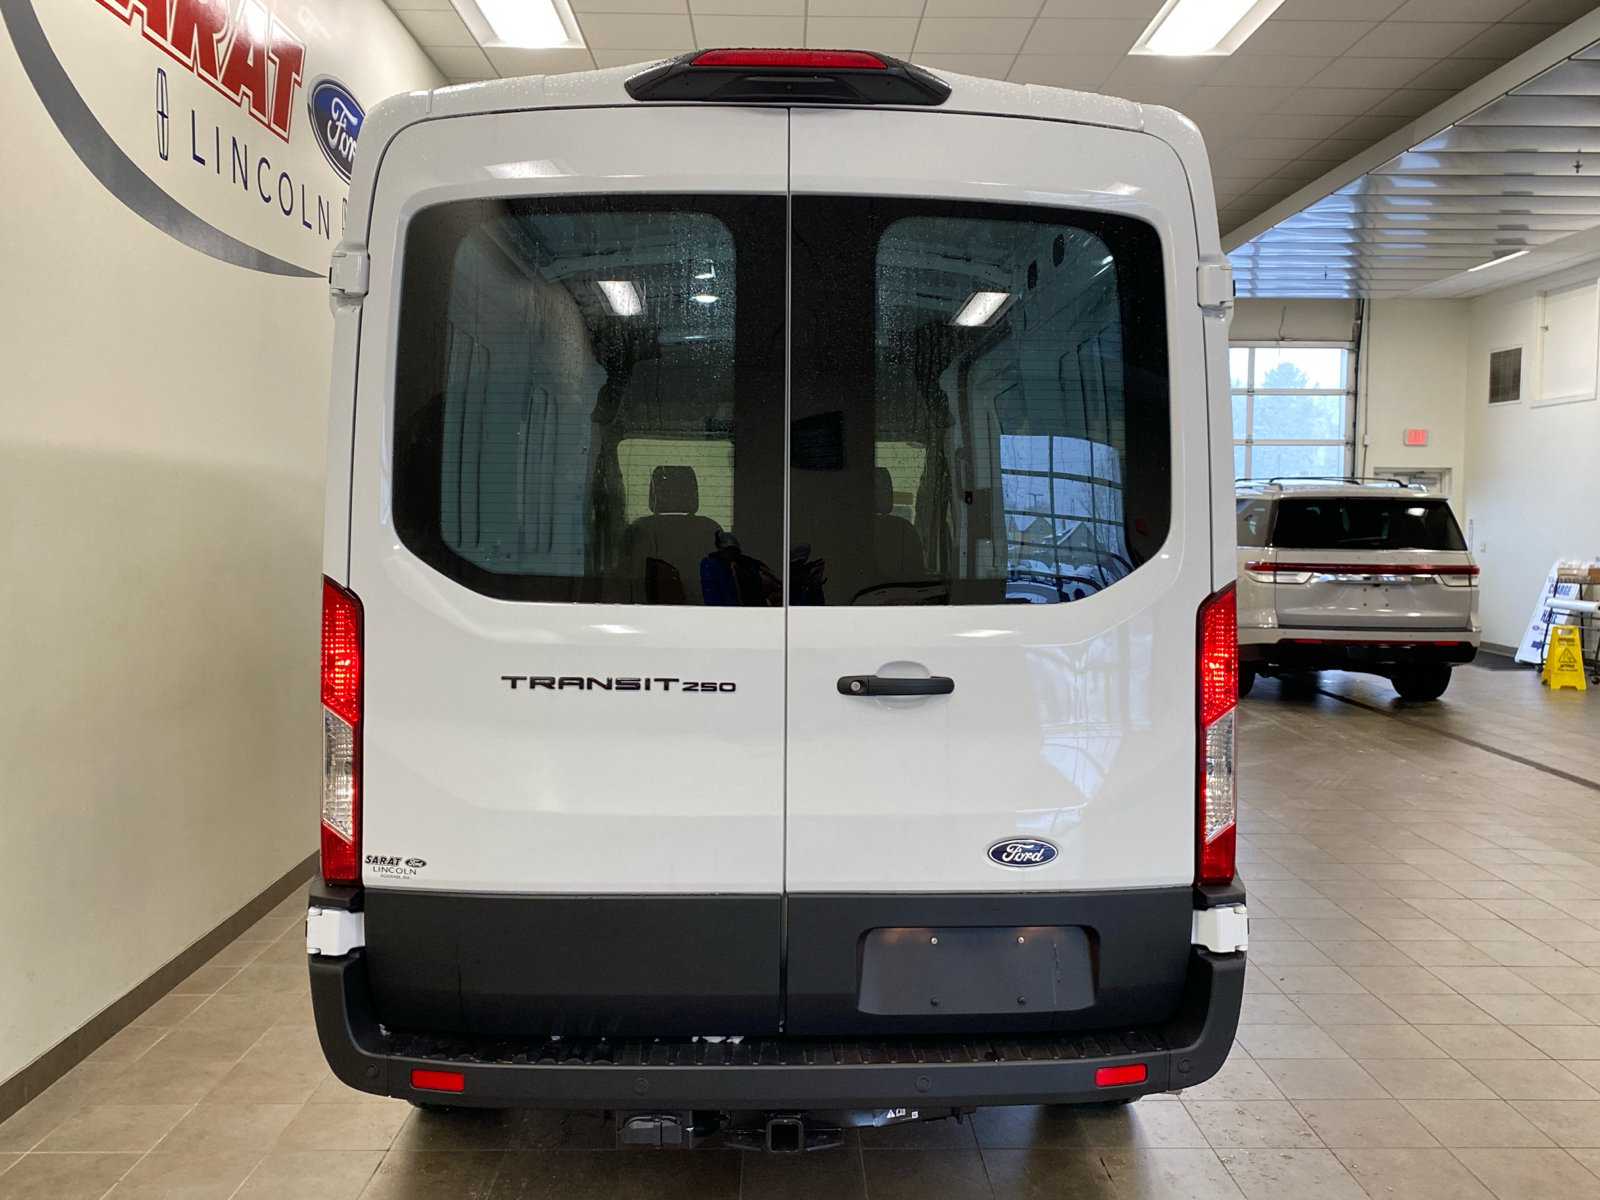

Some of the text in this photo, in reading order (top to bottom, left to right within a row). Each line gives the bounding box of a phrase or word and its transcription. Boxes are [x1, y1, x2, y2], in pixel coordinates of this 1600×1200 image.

[326, 96, 358, 162] For
[190, 109, 331, 240] LINCOLN
[1548, 583, 1572, 596] CARGE
[501, 675, 737, 692] TRANSIT 250
[365, 854, 402, 866] SARAT
[1001, 843, 1045, 862] Ford
[372, 866, 417, 875] LINCOLN
